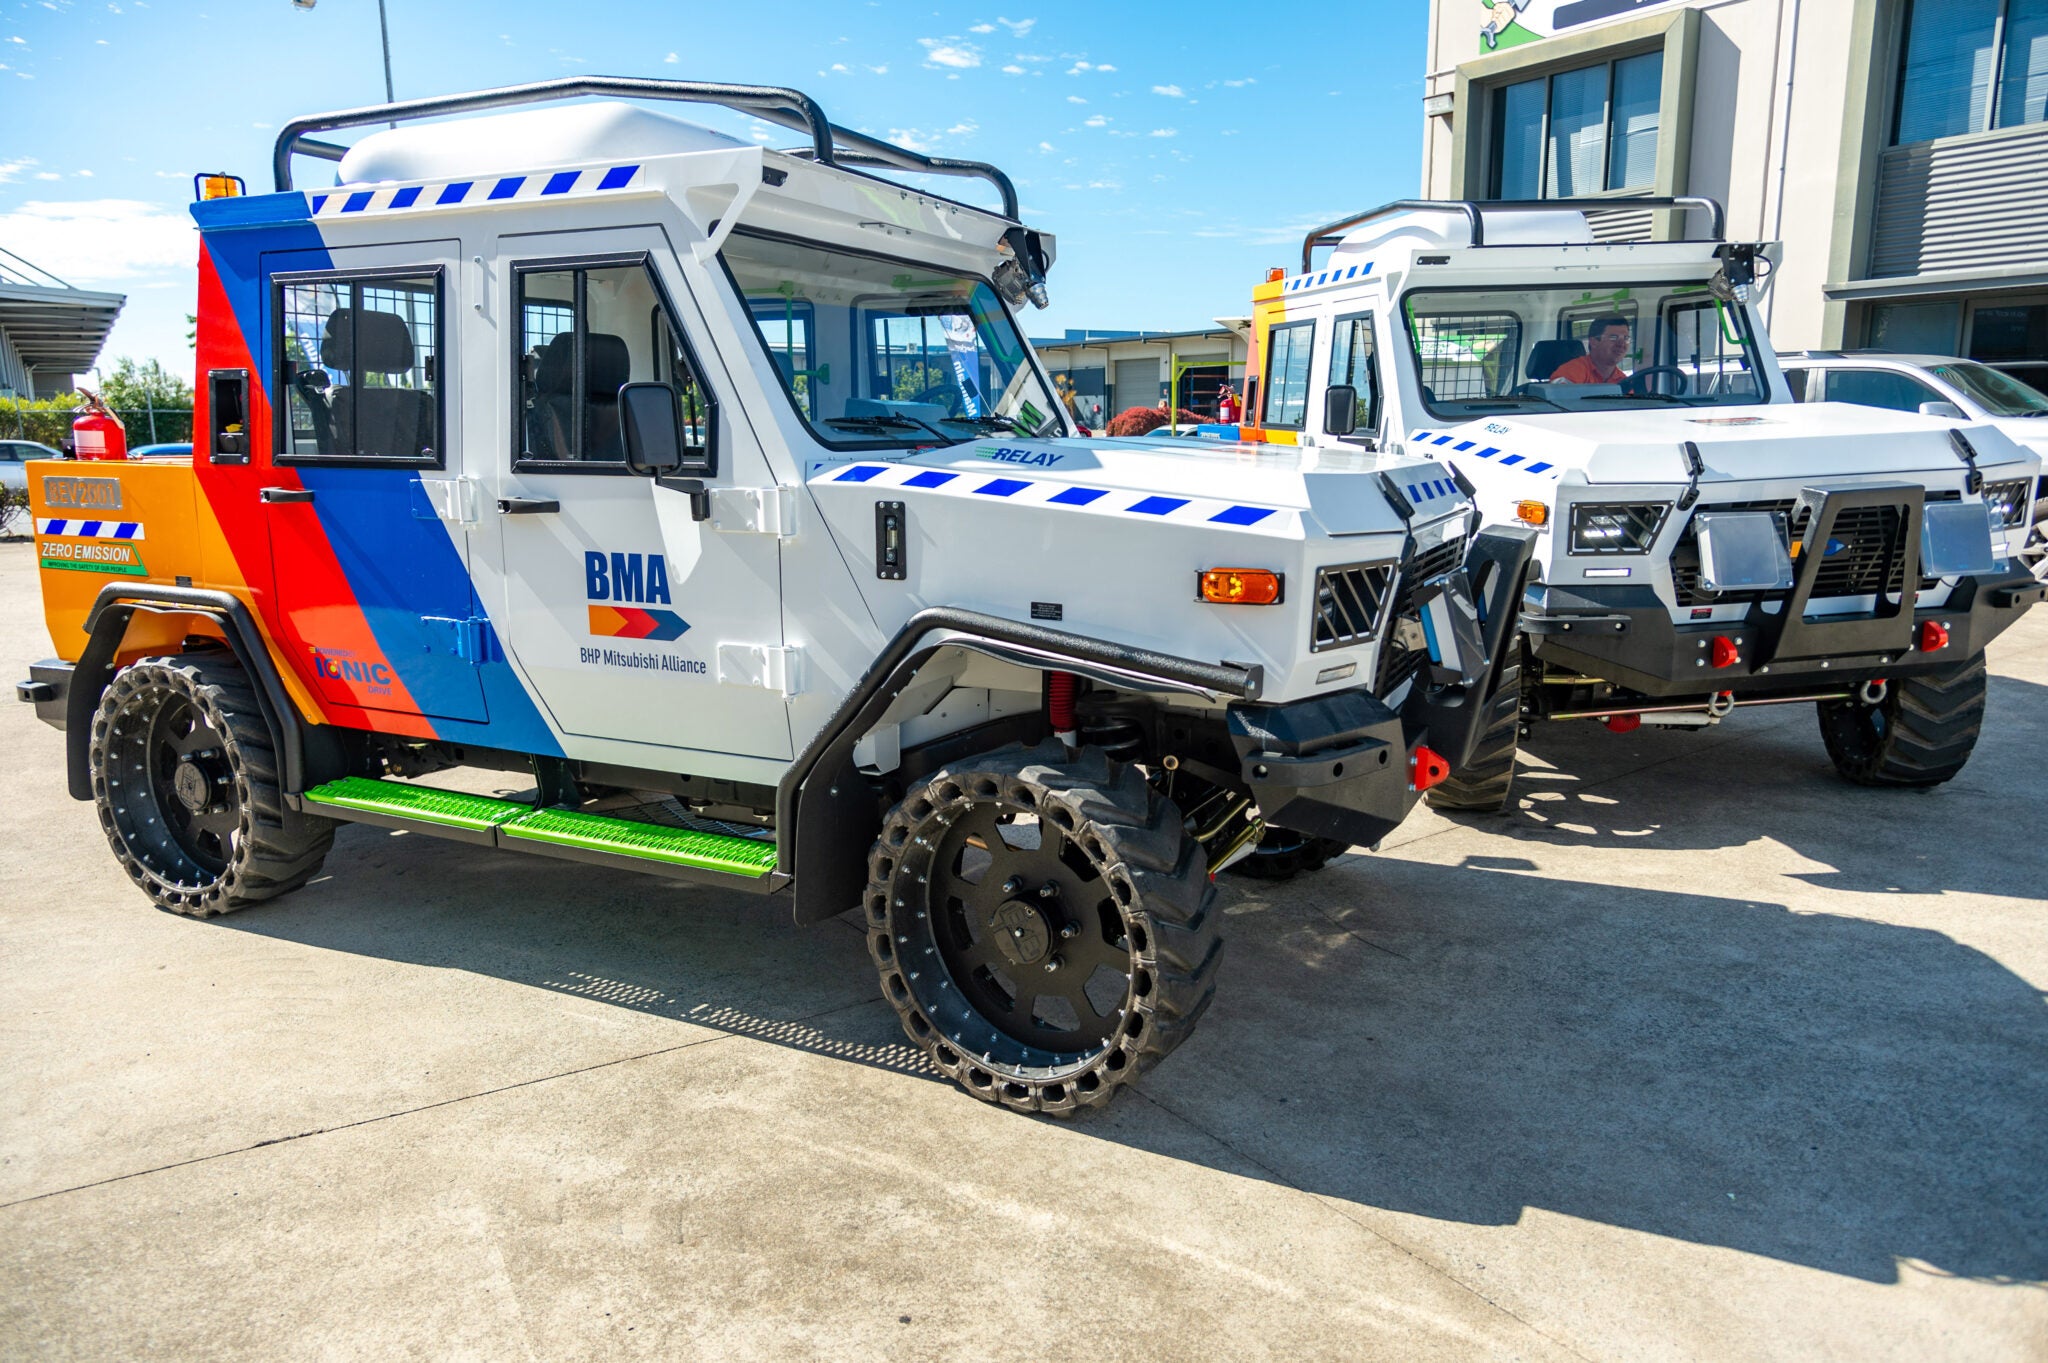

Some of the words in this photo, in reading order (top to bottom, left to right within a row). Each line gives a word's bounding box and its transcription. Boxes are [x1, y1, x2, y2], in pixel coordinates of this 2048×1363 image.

[992, 448, 1064, 467] RELAY
[48, 481, 115, 505] BEV2001
[42, 542, 73, 558] ZERO
[74, 544, 131, 562] EMISSION
[585, 551, 672, 605] BMA
[314, 657, 391, 685] IONIC
[580, 647, 601, 664] BHP
[603, 649, 659, 670] Mitsubishi
[661, 654, 706, 674] Alliance
[368, 685, 392, 696] DRIVE
